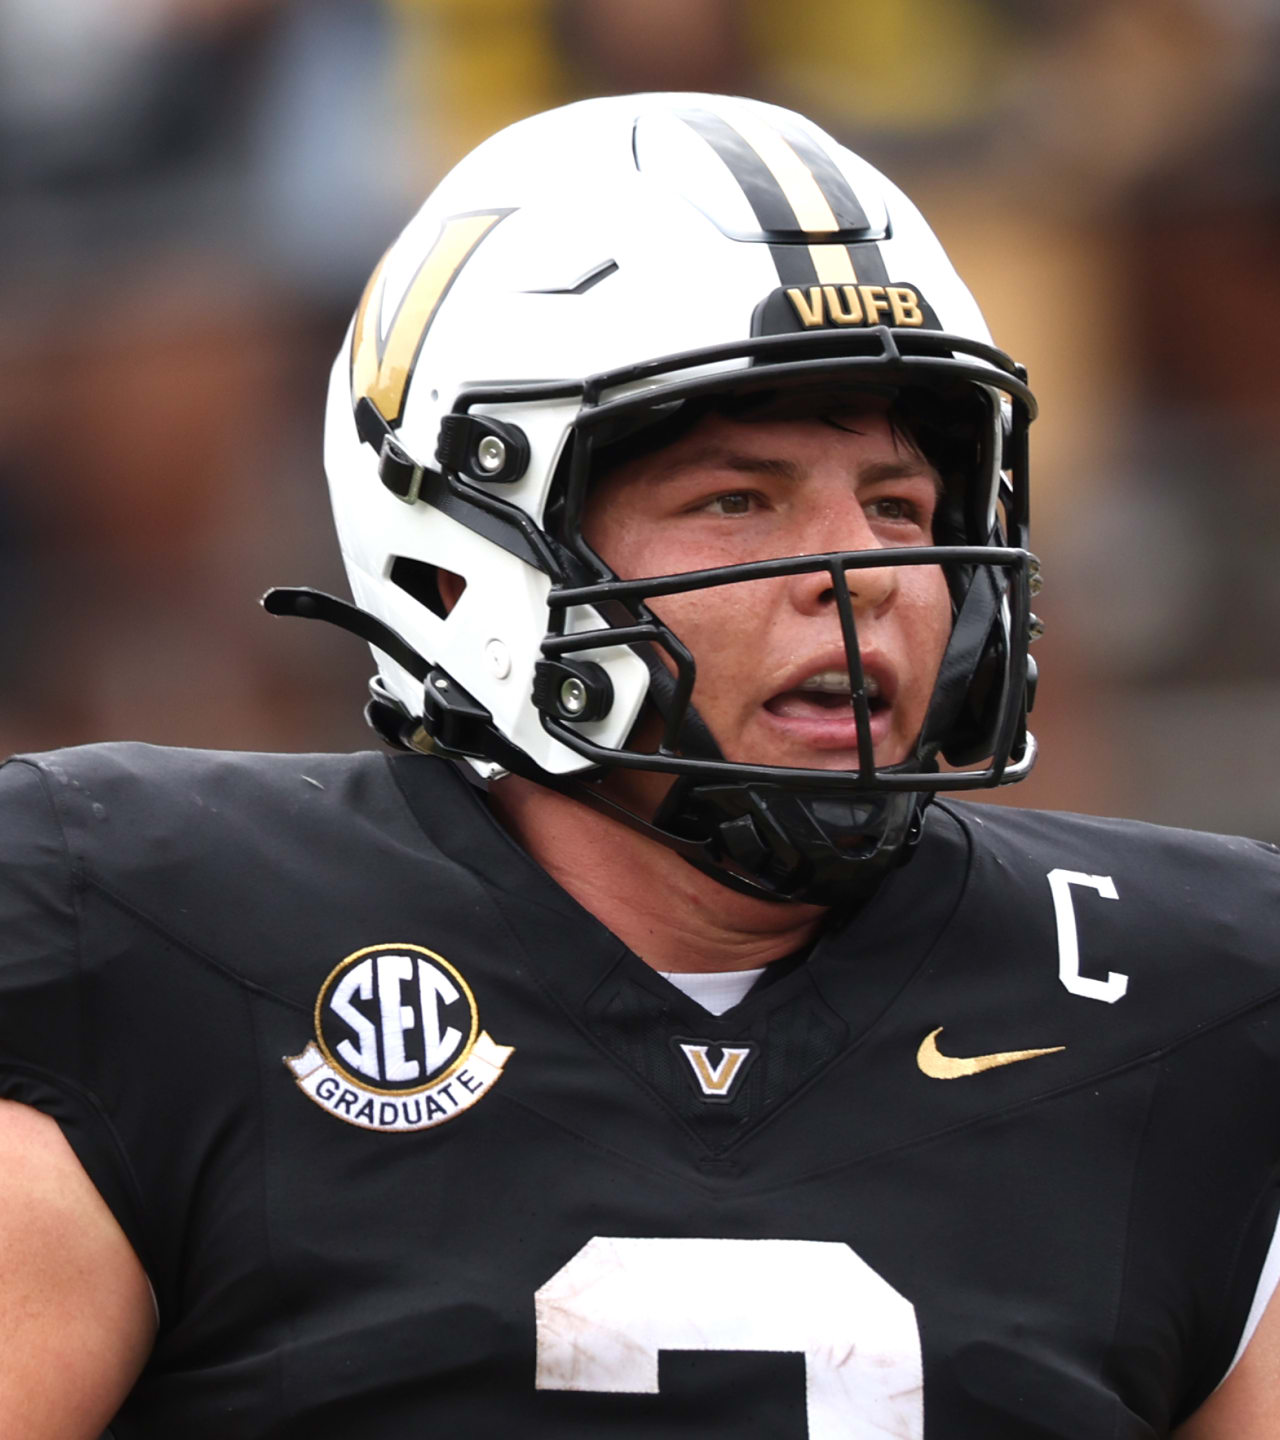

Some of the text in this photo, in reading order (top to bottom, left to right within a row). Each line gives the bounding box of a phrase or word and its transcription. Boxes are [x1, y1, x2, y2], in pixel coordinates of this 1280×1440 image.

[786, 285, 924, 327] VUFB
[1047, 868, 1129, 1004] C
[331, 955, 463, 1082] SEC
[315, 1068, 484, 1126] GRADUATE
[679, 1043, 751, 1096] V
